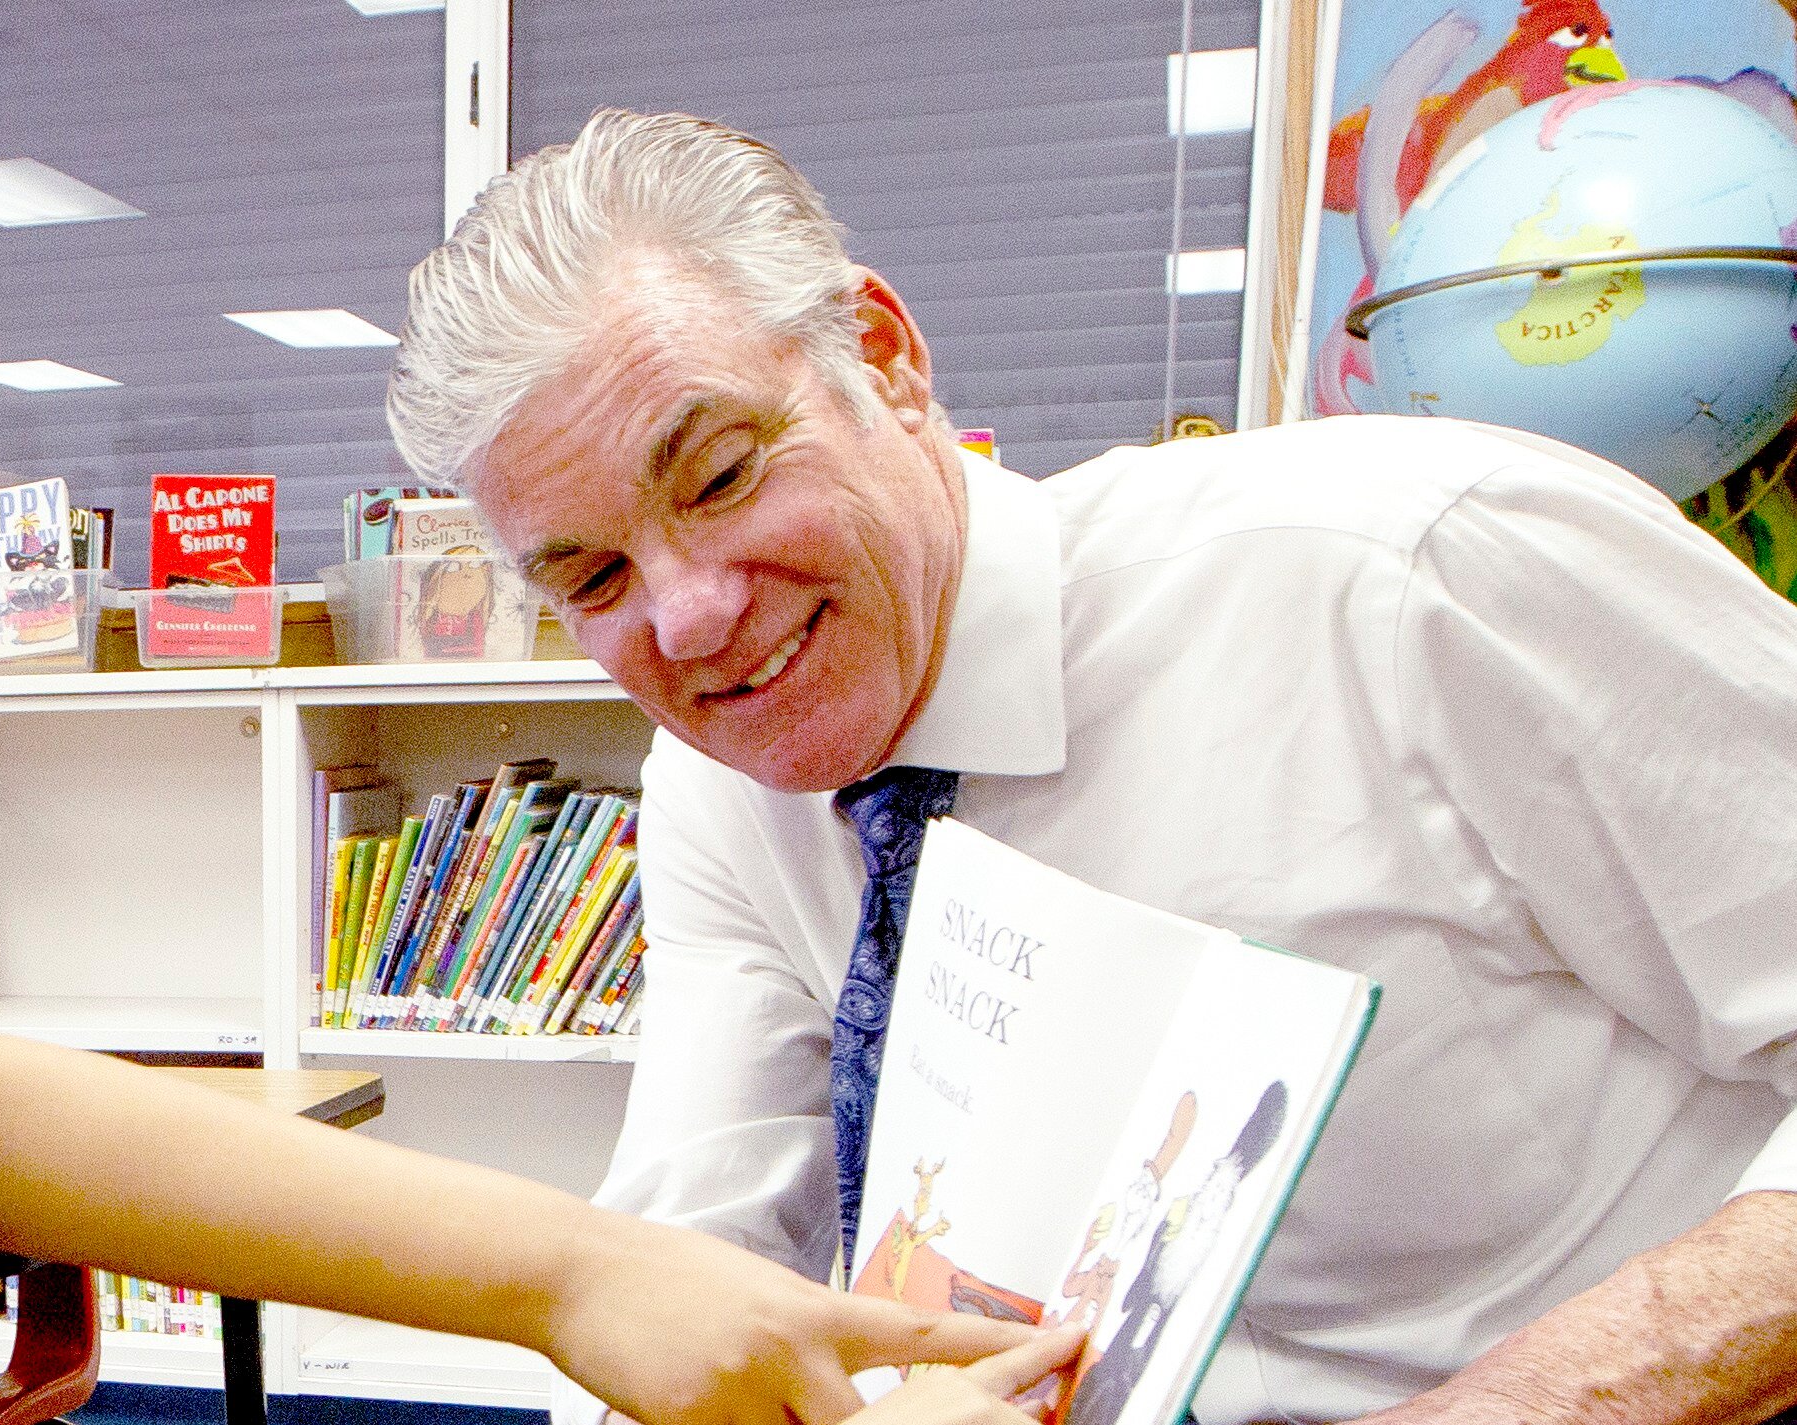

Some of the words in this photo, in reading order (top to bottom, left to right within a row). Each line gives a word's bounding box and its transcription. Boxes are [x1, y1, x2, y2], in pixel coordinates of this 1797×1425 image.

[1522, 235, 1628, 341] ATARCTICA
[154, 490, 183, 512] AL
[185, 485, 269, 509] CAPONE
[167, 513, 217, 534] DOES
[221, 508, 253, 528] MY
[180, 534, 247, 555] SHIRTS
[411, 530, 456, 550] Spells
[940, 898, 1046, 981] SNACK
[925, 960, 1020, 1045] SNACK
